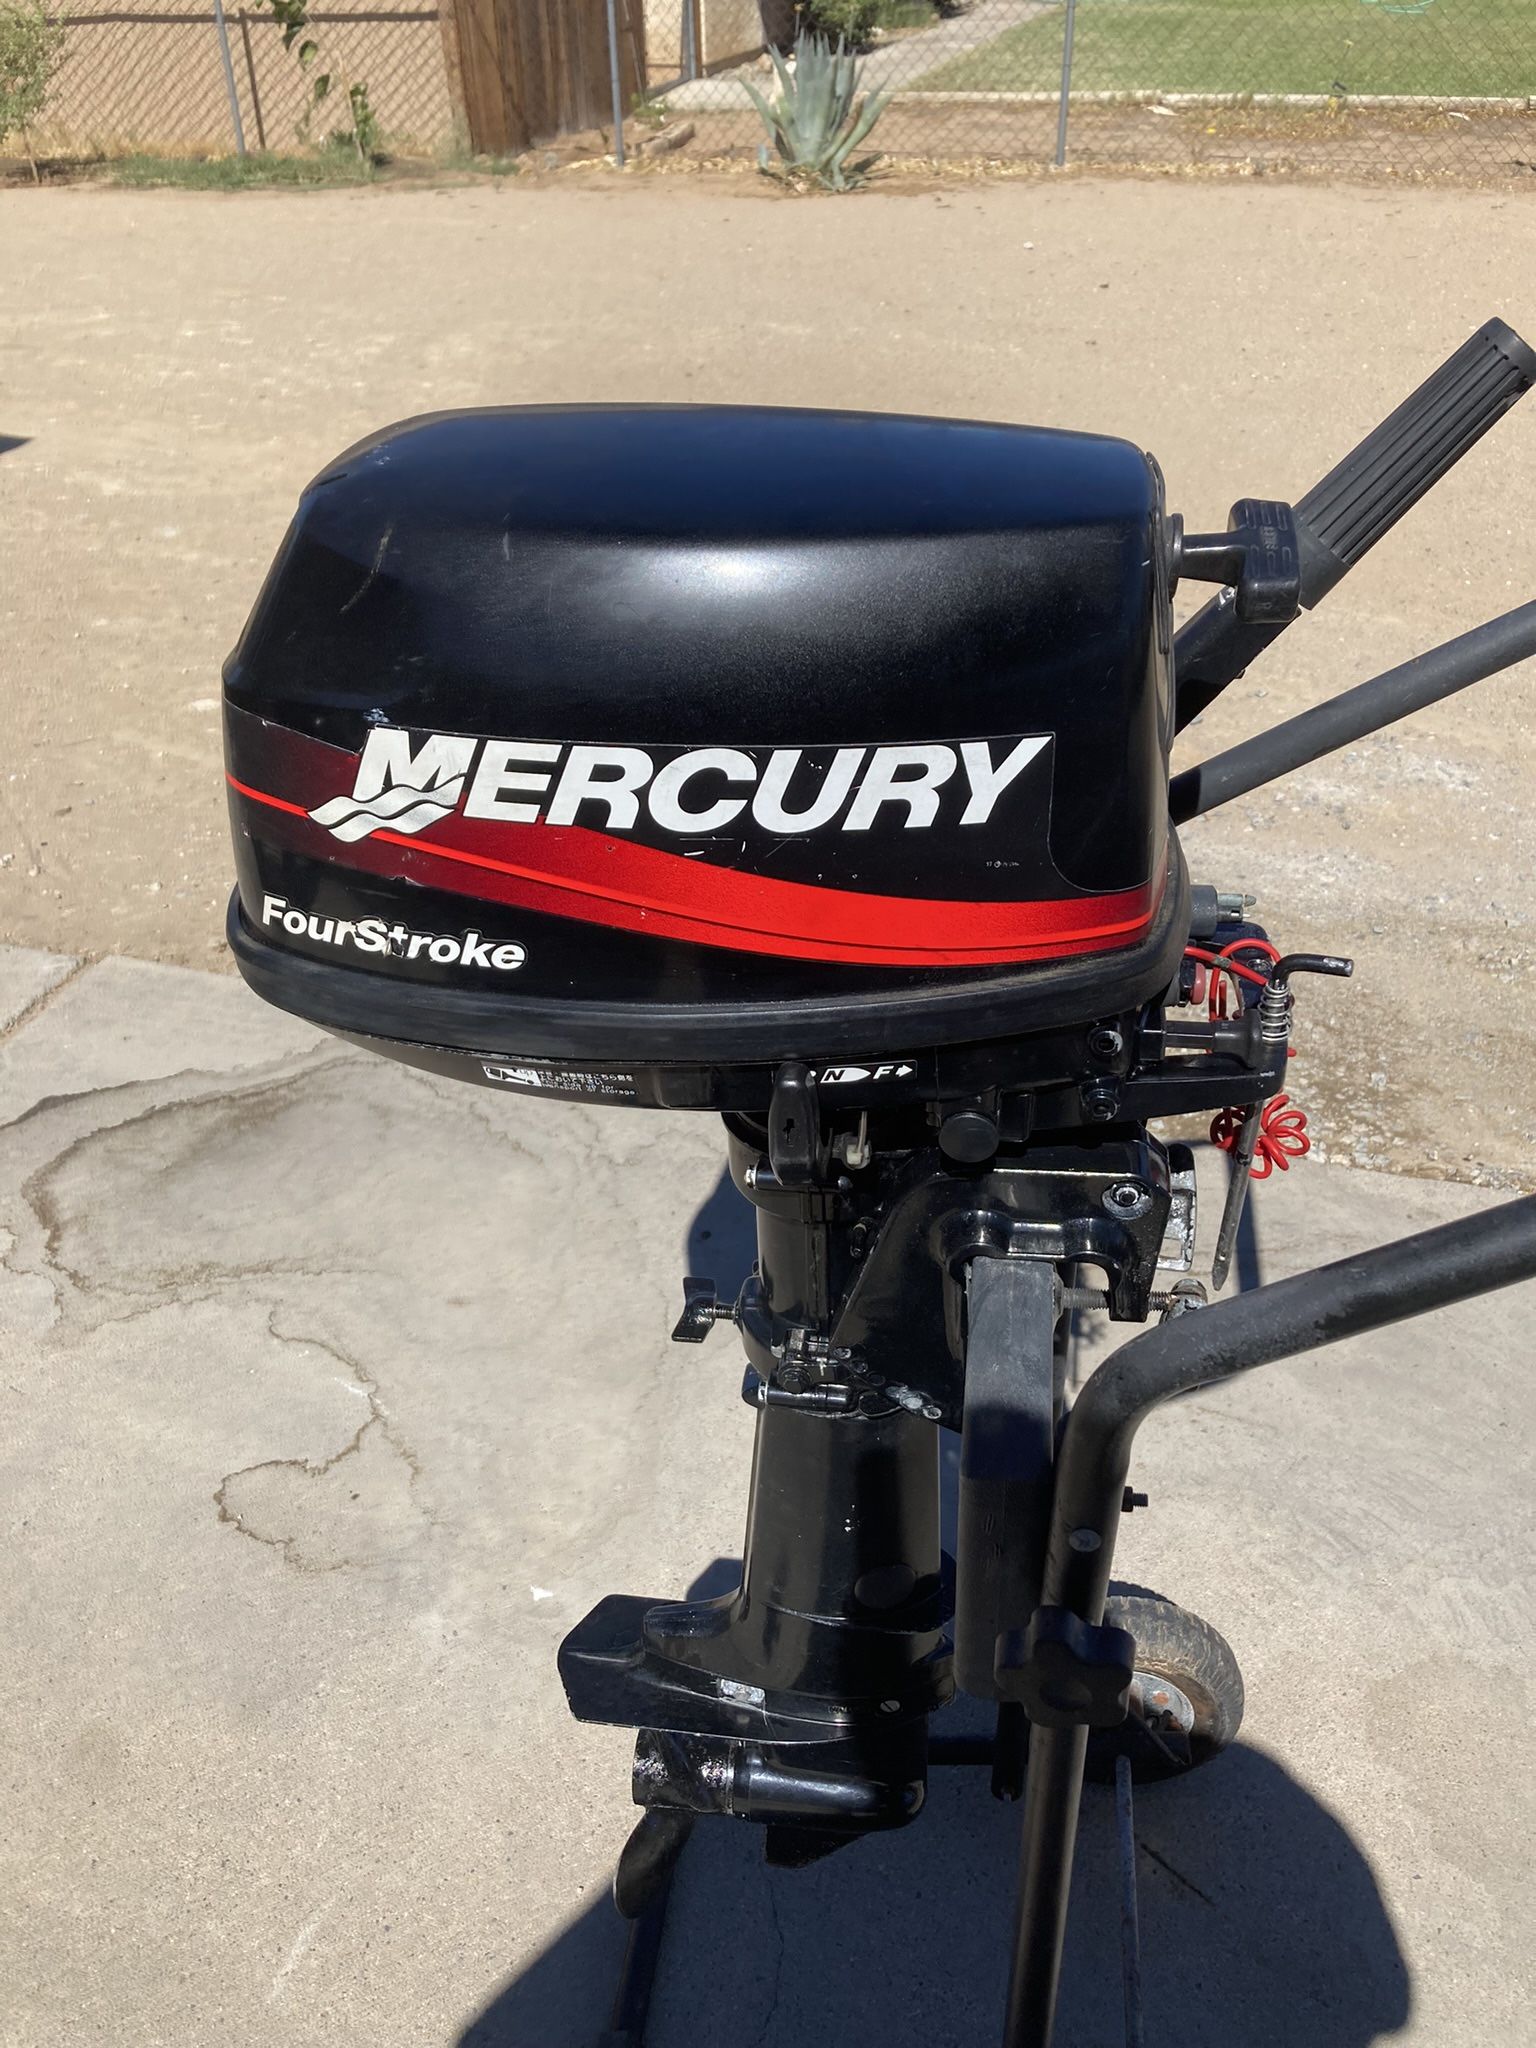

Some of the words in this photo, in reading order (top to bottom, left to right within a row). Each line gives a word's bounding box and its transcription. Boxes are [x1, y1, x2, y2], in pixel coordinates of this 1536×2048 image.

[350, 723, 1053, 834] MERCURY
[262, 894, 527, 970] FourStroke
[823, 1069, 846, 1081] N
[872, 1065, 894, 1080] F
